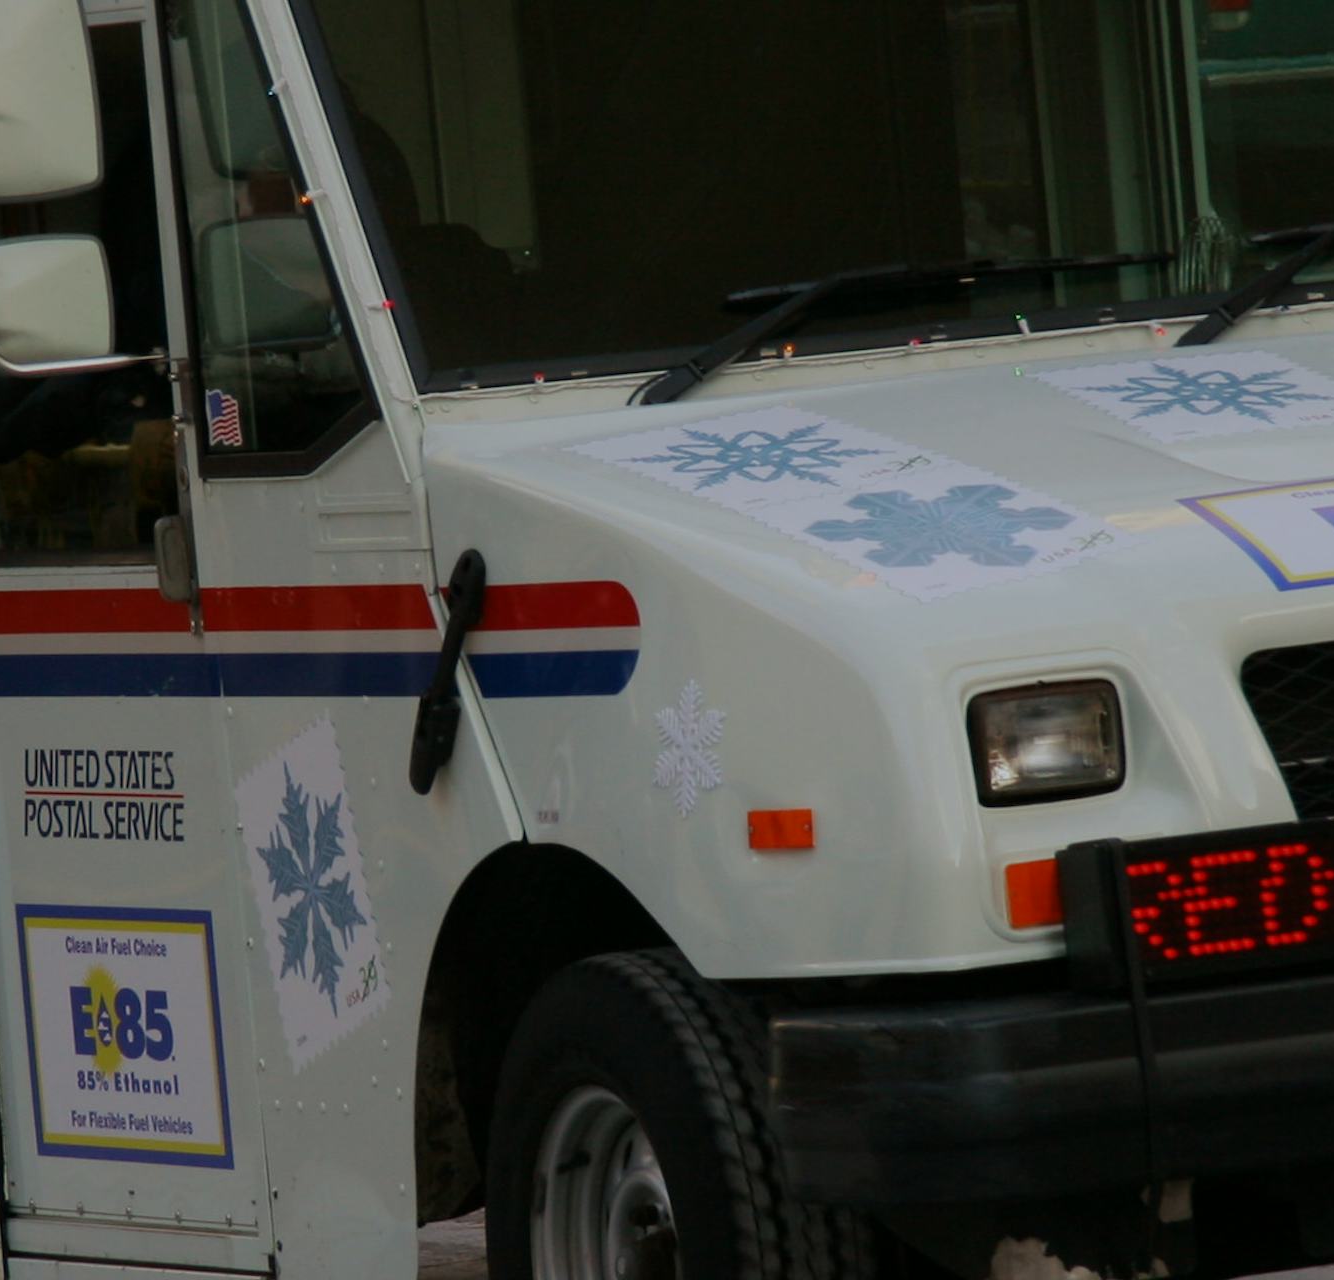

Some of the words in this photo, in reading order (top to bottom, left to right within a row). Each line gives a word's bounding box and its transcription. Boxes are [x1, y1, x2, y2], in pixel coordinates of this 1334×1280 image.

[25, 749, 101, 788] UNITED
[104, 750, 175, 790] STATES
[24, 799, 100, 840] POSTAL
[103, 801, 185, 842] SERVICE
[65, 936, 93, 954] Clean
[95, 937, 108, 954] Air
[111, 938, 132, 956] Fuel
[133, 938, 167, 957] Choice
[77, 1069, 109, 1092] 85%
[113, 1071, 180, 1096] Ethanol
[70, 1109, 87, 1128] For
[88, 1111, 127, 1130] Flexible
[128, 1112, 150, 1132] Fuel
[151, 1114, 194, 1135] Vehicles
